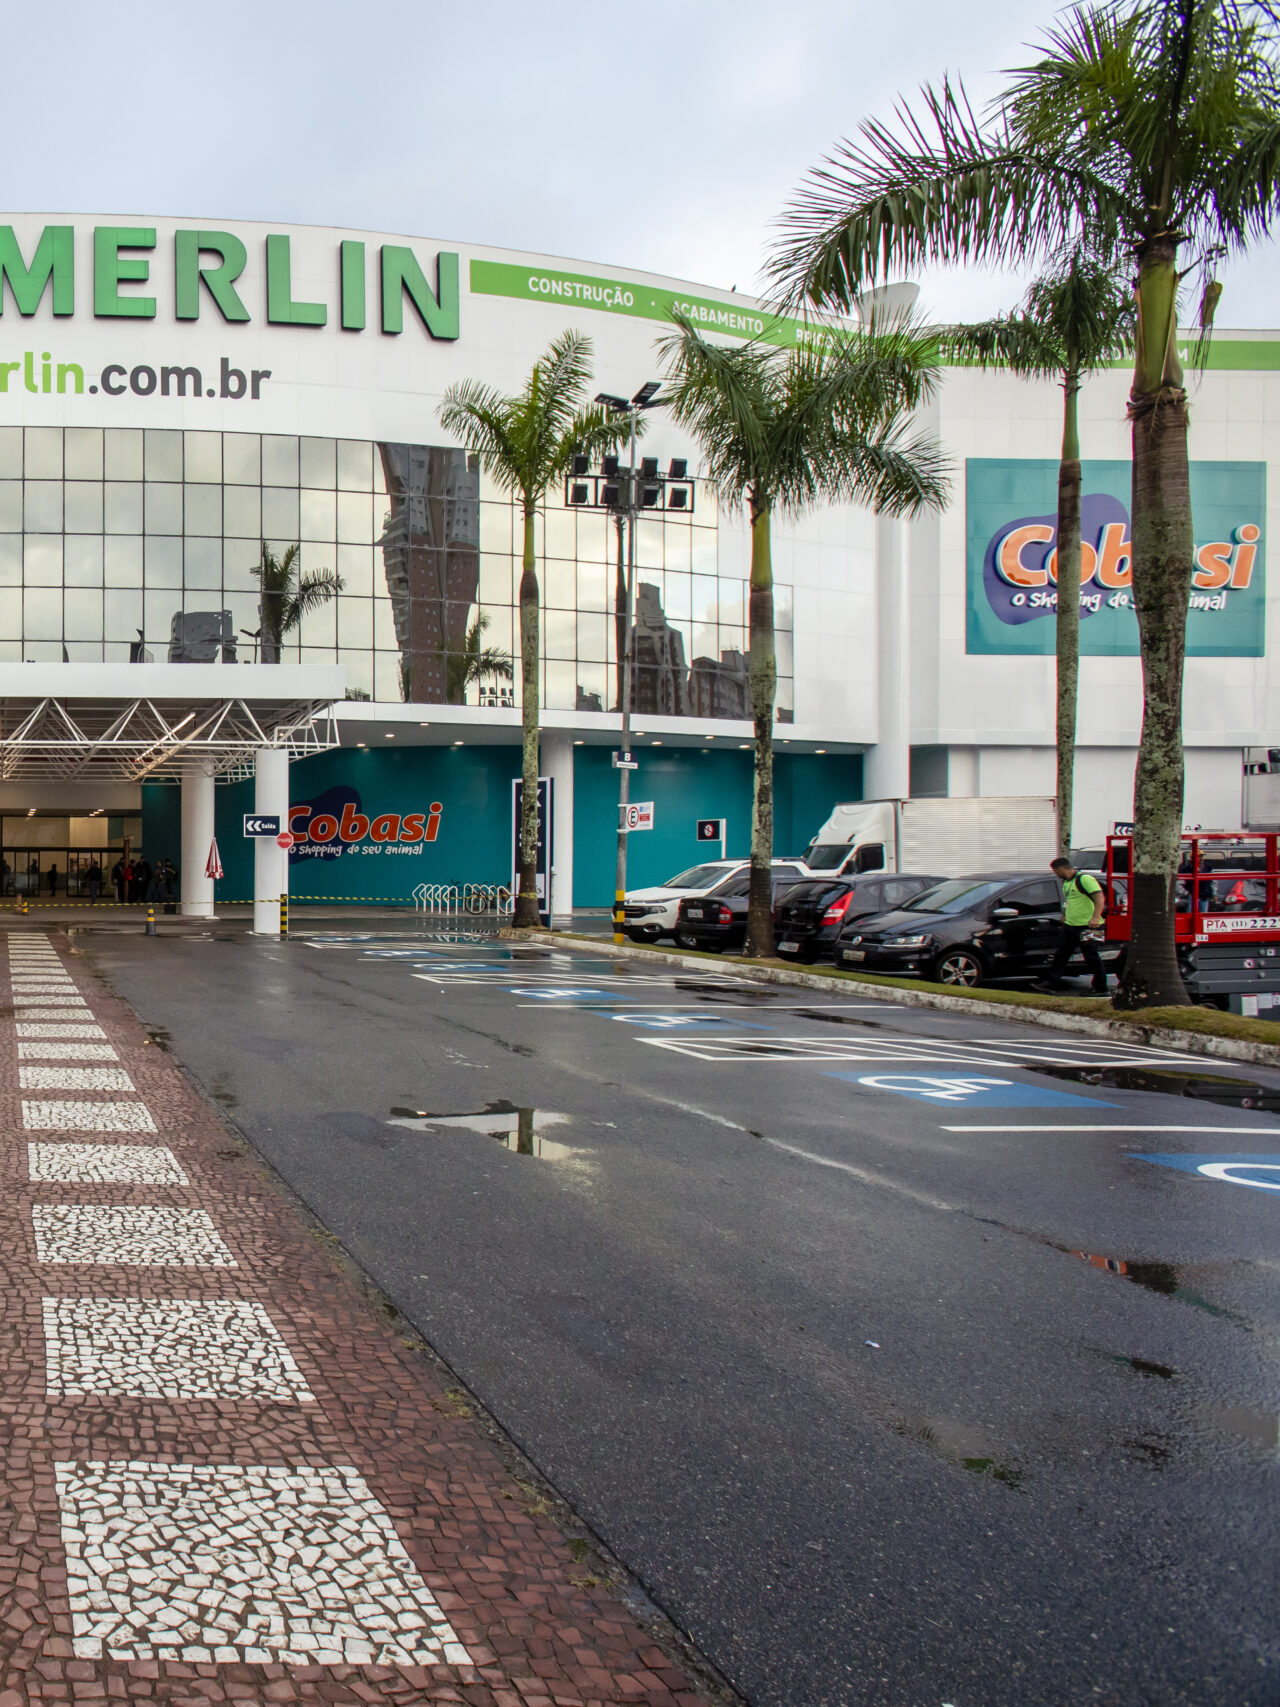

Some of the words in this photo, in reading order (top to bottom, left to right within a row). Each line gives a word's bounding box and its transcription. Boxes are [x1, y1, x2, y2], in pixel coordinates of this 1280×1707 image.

[528, 276, 634, 308] CONSTRUÇÃO
[997, 522, 1261, 589] Cobsi
[624, 752, 631, 761] B
[288, 802, 442, 843] Cobasi
[347, 843, 360, 854] do
[385, 843, 423, 856] animal
[1207, 920, 1227, 928] PTA
